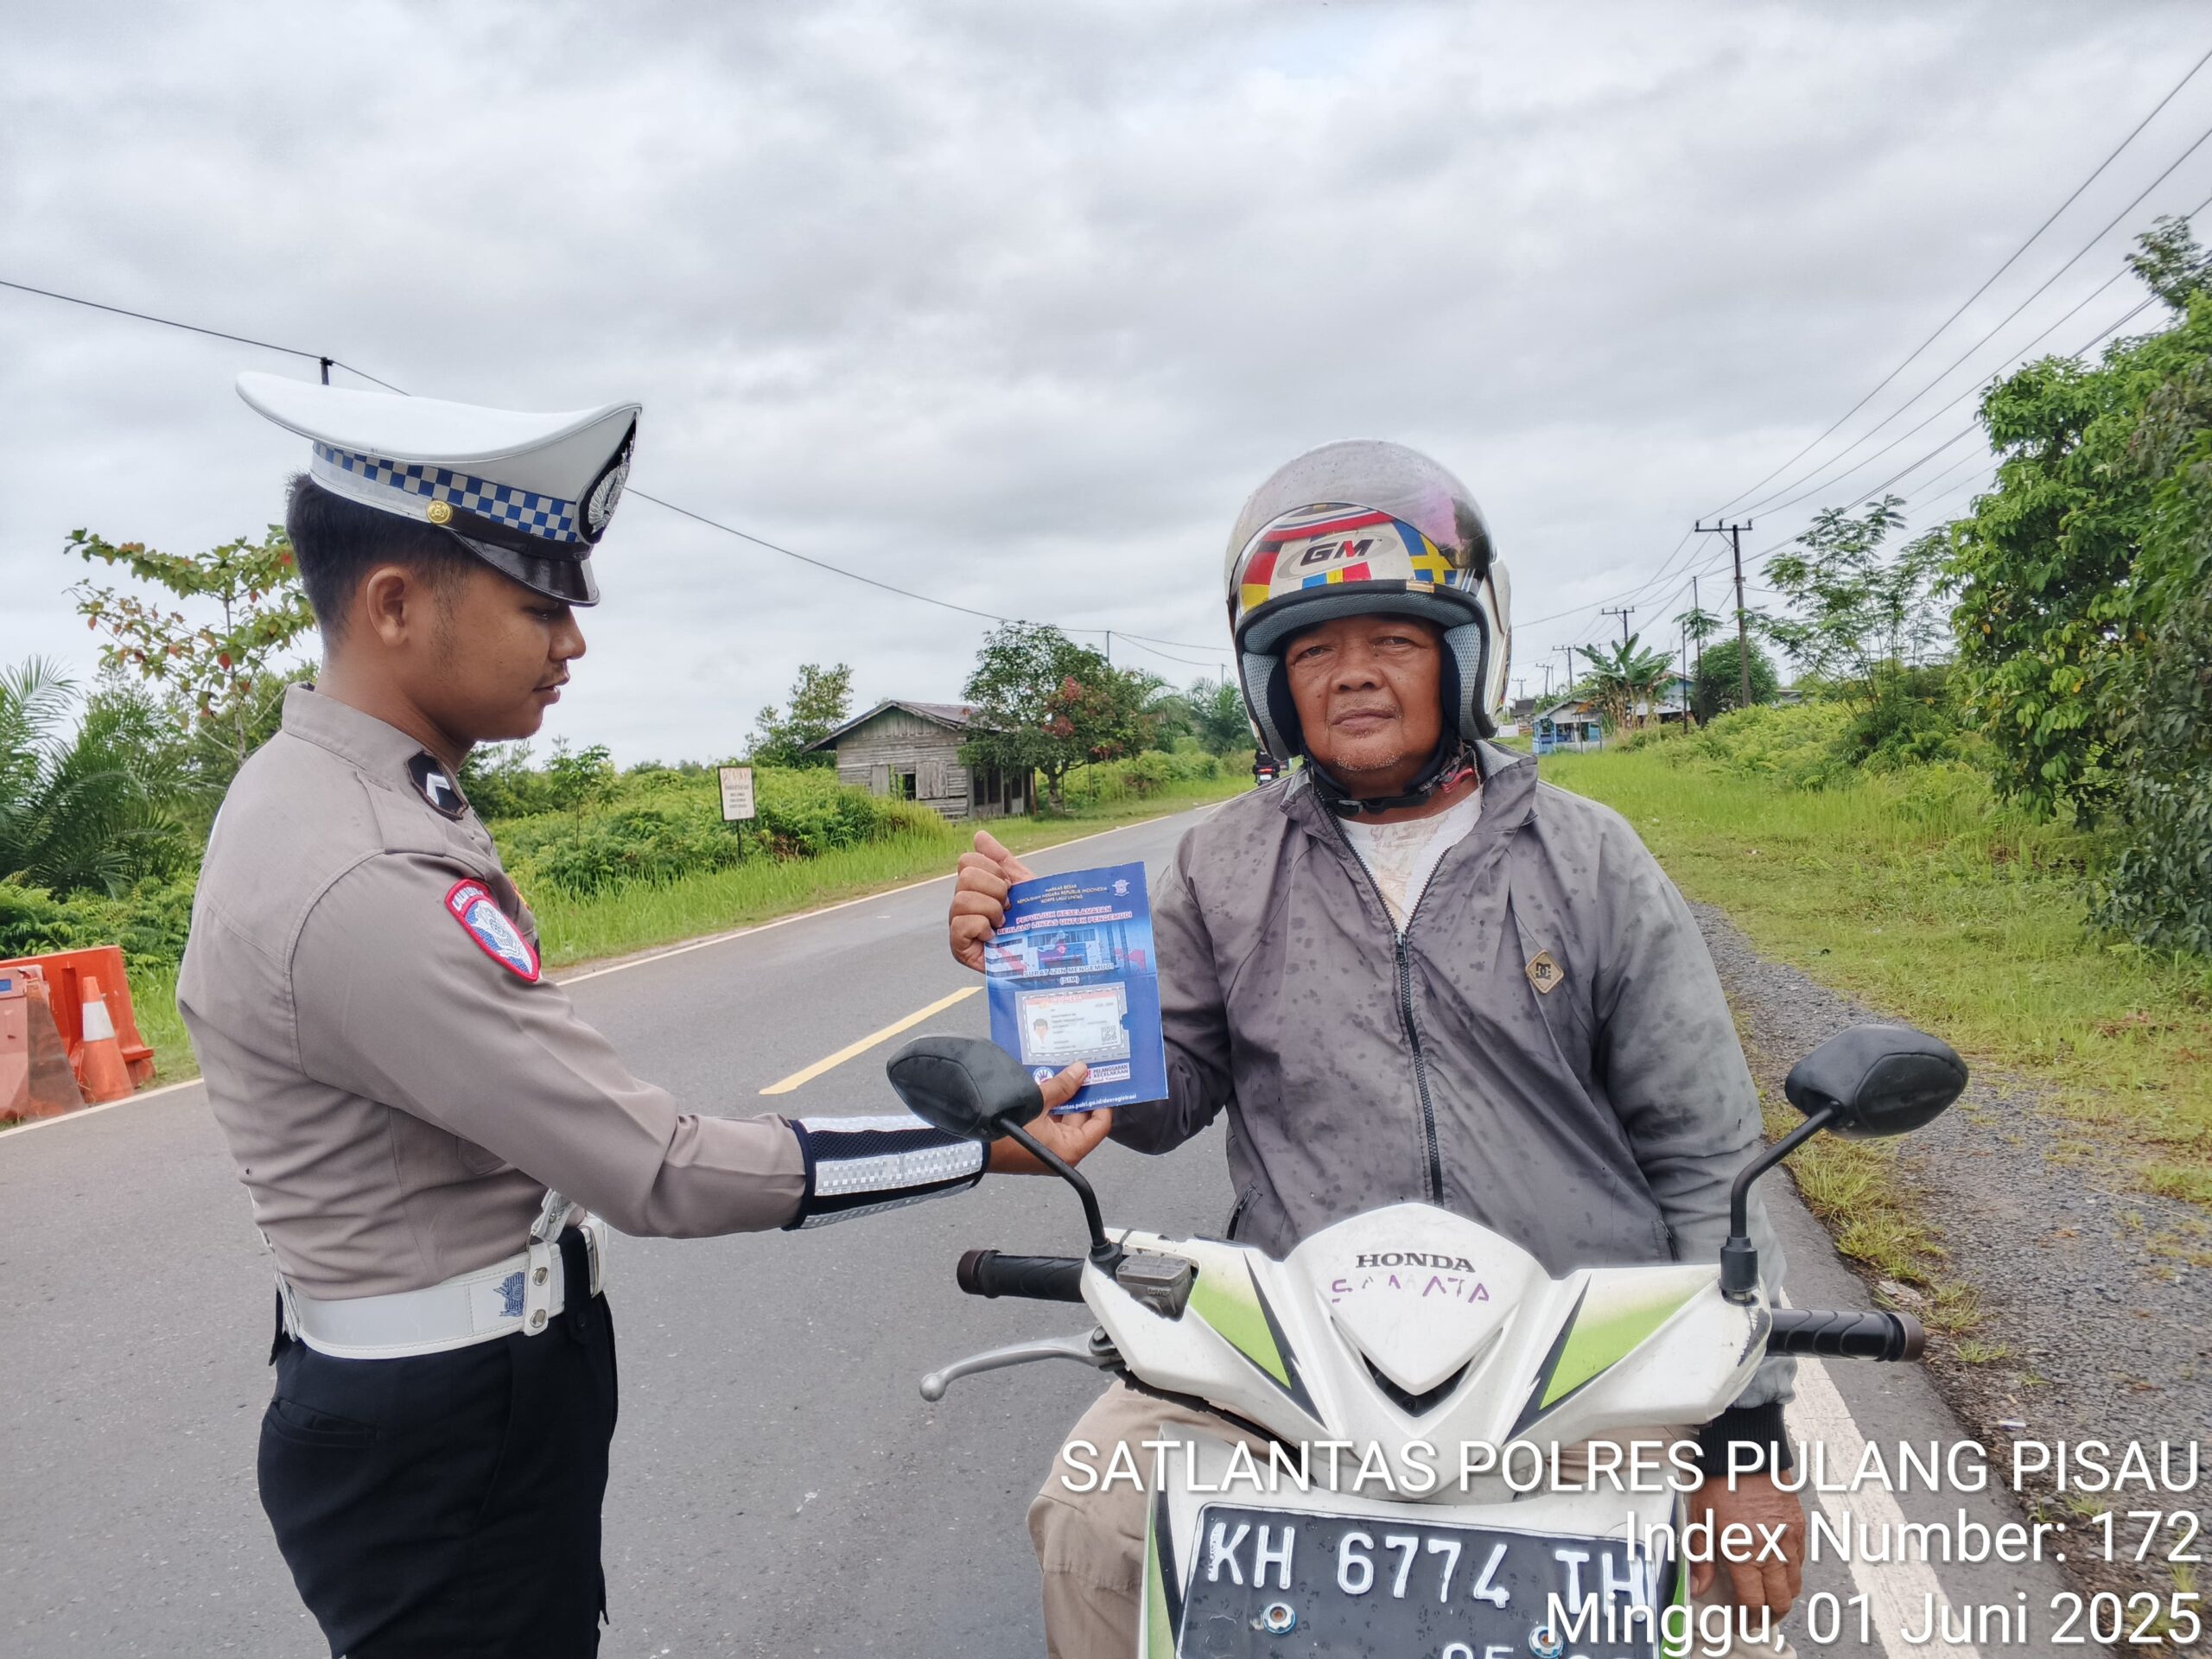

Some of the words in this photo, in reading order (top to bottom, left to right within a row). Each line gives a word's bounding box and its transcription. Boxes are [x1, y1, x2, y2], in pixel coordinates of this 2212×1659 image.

[1300, 538, 1374, 567] GM
[1082, 886, 1108, 894] INDONESIA
[997, 924, 1031, 936] BERLALU
[1031, 918, 1058, 930] LINTAS
[1059, 915, 1087, 926] UNTUK
[1088, 911, 1133, 924] PENGEMUDI
[1016, 911, 1056, 925] PETUNJUK
[1057, 906, 1112, 918] KESELAMATAN
[1023, 969, 1049, 978] SURAT
[1067, 963, 1115, 974] MENGEMUDI
[1059, 976, 1080, 985] (SIM)
[1093, 1064, 1128, 1074] PELANGGARAN
[1093, 1070, 1128, 1078] KECELAKAAN
[1356, 1252, 1476, 1273] HONDA
[1208, 1522, 1295, 1590] KH
[1337, 1532, 1511, 1609] 6774
[1555, 1549, 1648, 1623] TH
